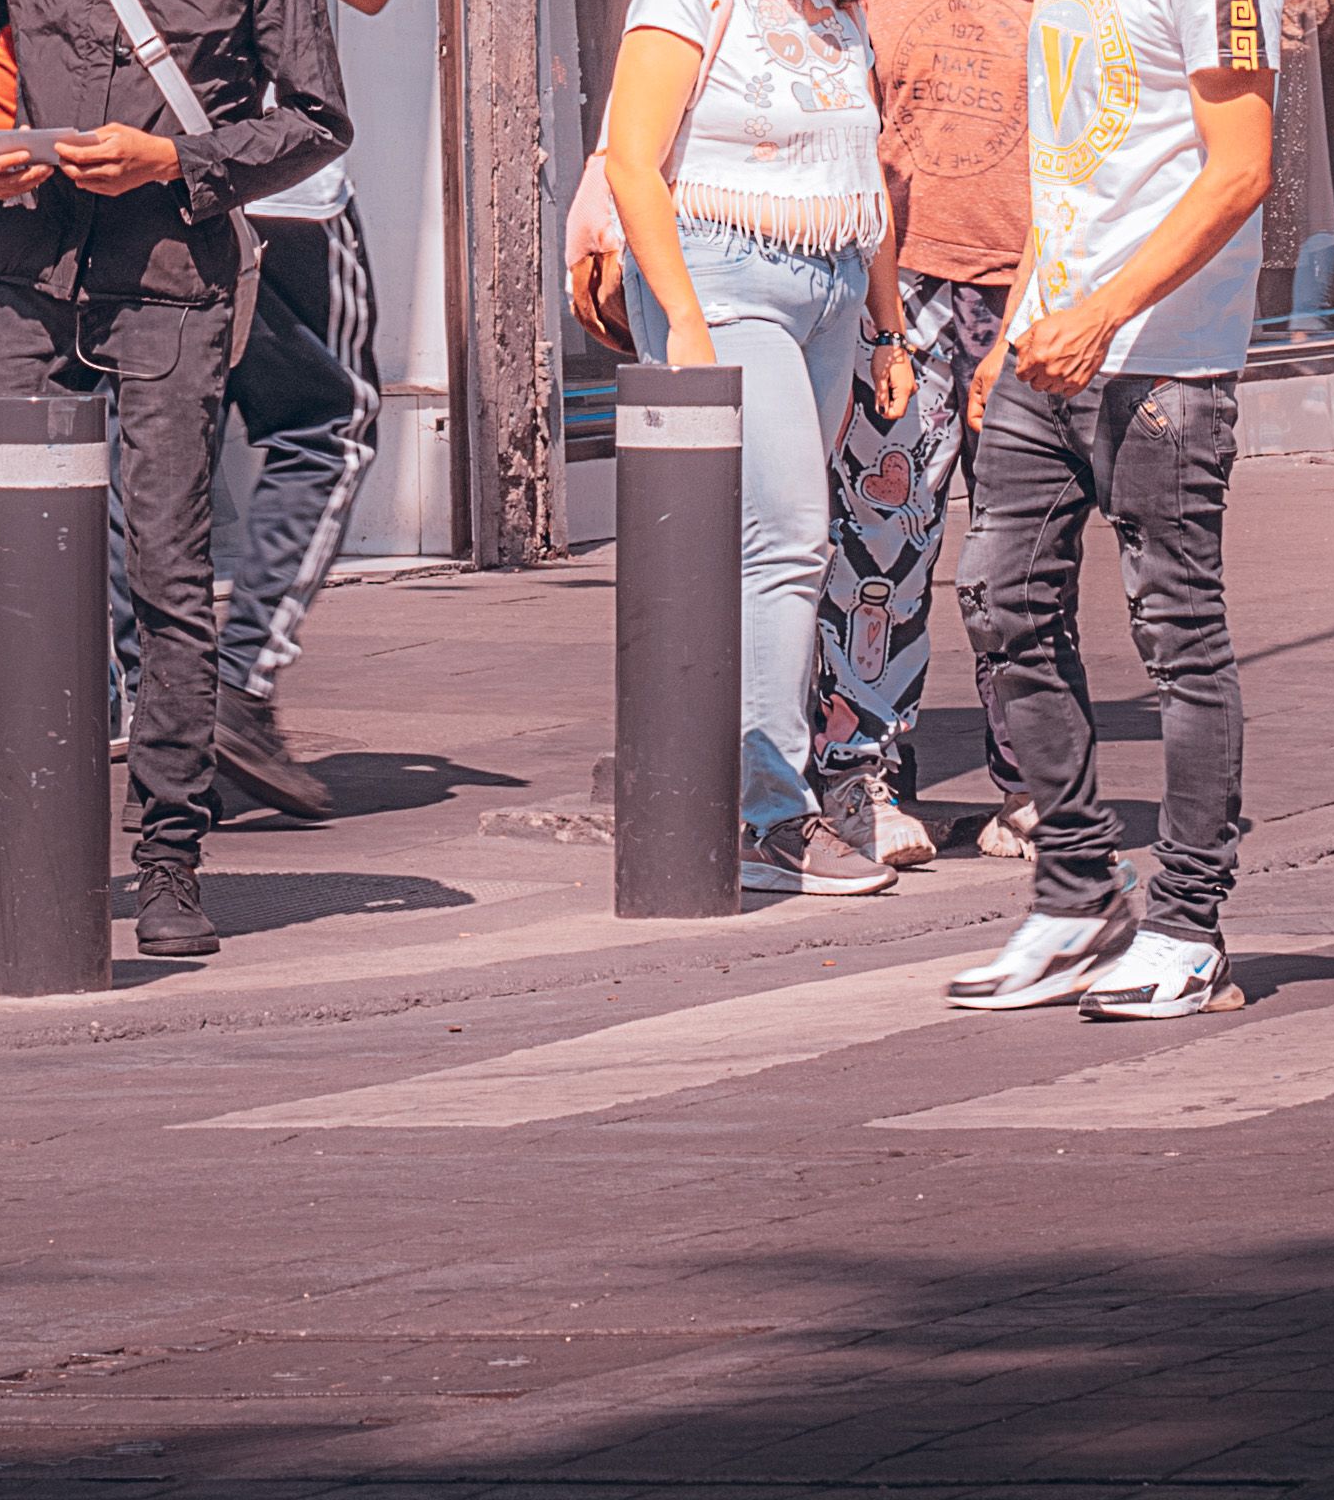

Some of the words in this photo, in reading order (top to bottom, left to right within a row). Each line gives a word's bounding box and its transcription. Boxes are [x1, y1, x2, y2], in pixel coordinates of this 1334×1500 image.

[951, 22, 986, 42] 1972
[931, 52, 993, 80] MAKE
[911, 79, 1004, 113] EXCUSES
[786, 127, 839, 166] HELLO
